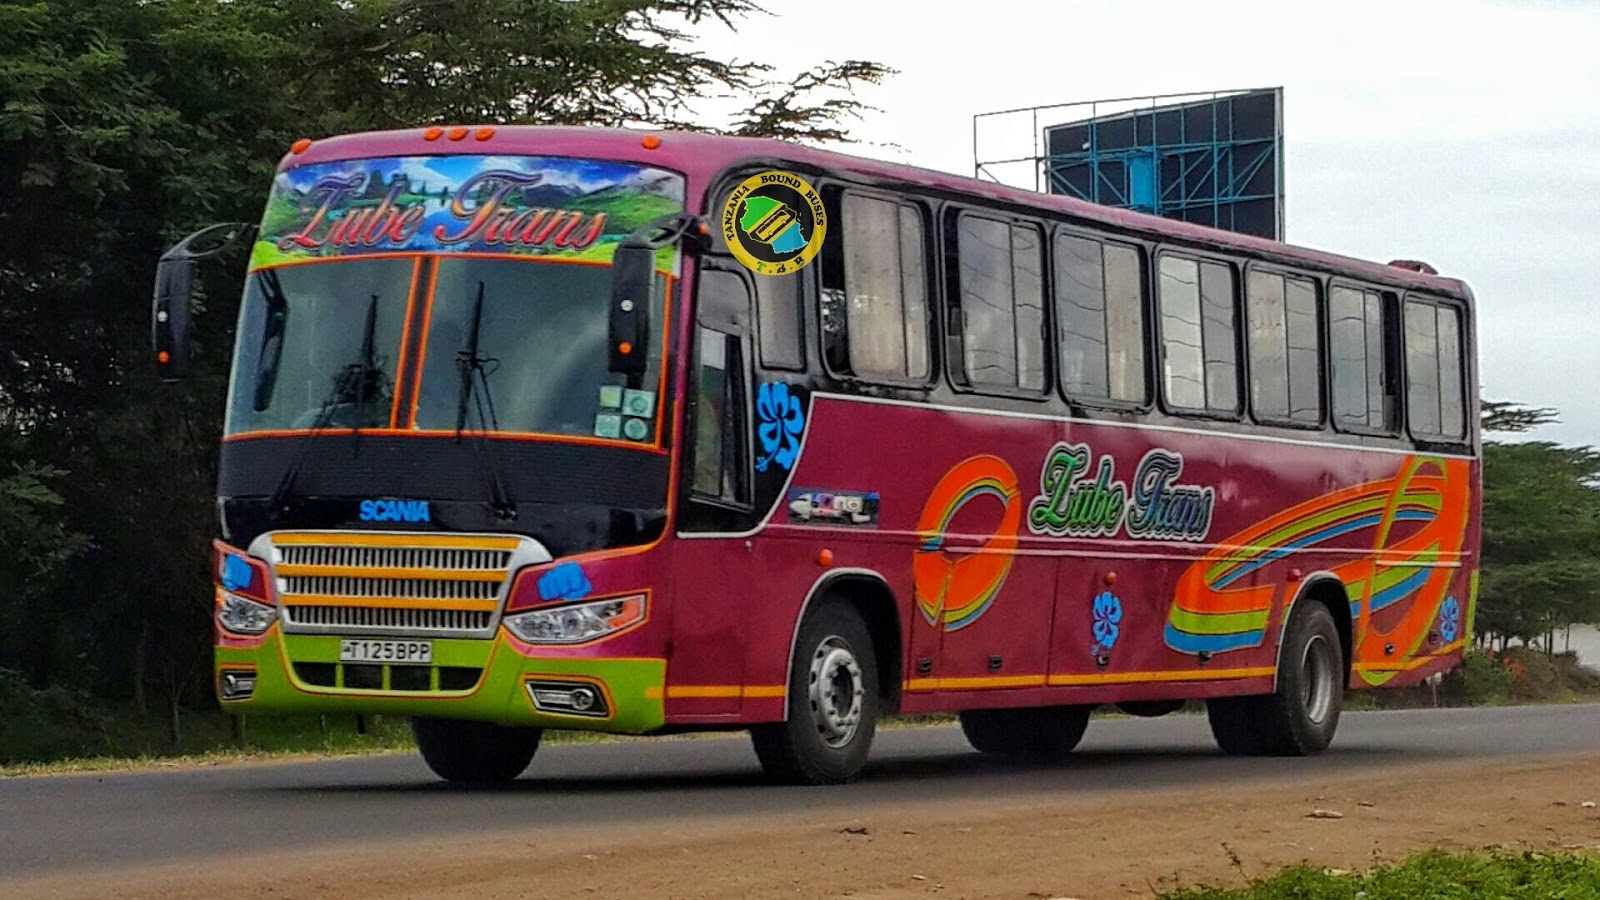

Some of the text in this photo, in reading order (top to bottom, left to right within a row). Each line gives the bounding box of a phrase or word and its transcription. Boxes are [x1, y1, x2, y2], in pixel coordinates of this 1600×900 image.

[278, 169, 608, 251] Lube Trans
[359, 500, 431, 522] SCANIA
[1125, 449, 1215, 541] Trans
[350, 641, 430, 660] T125BPP
